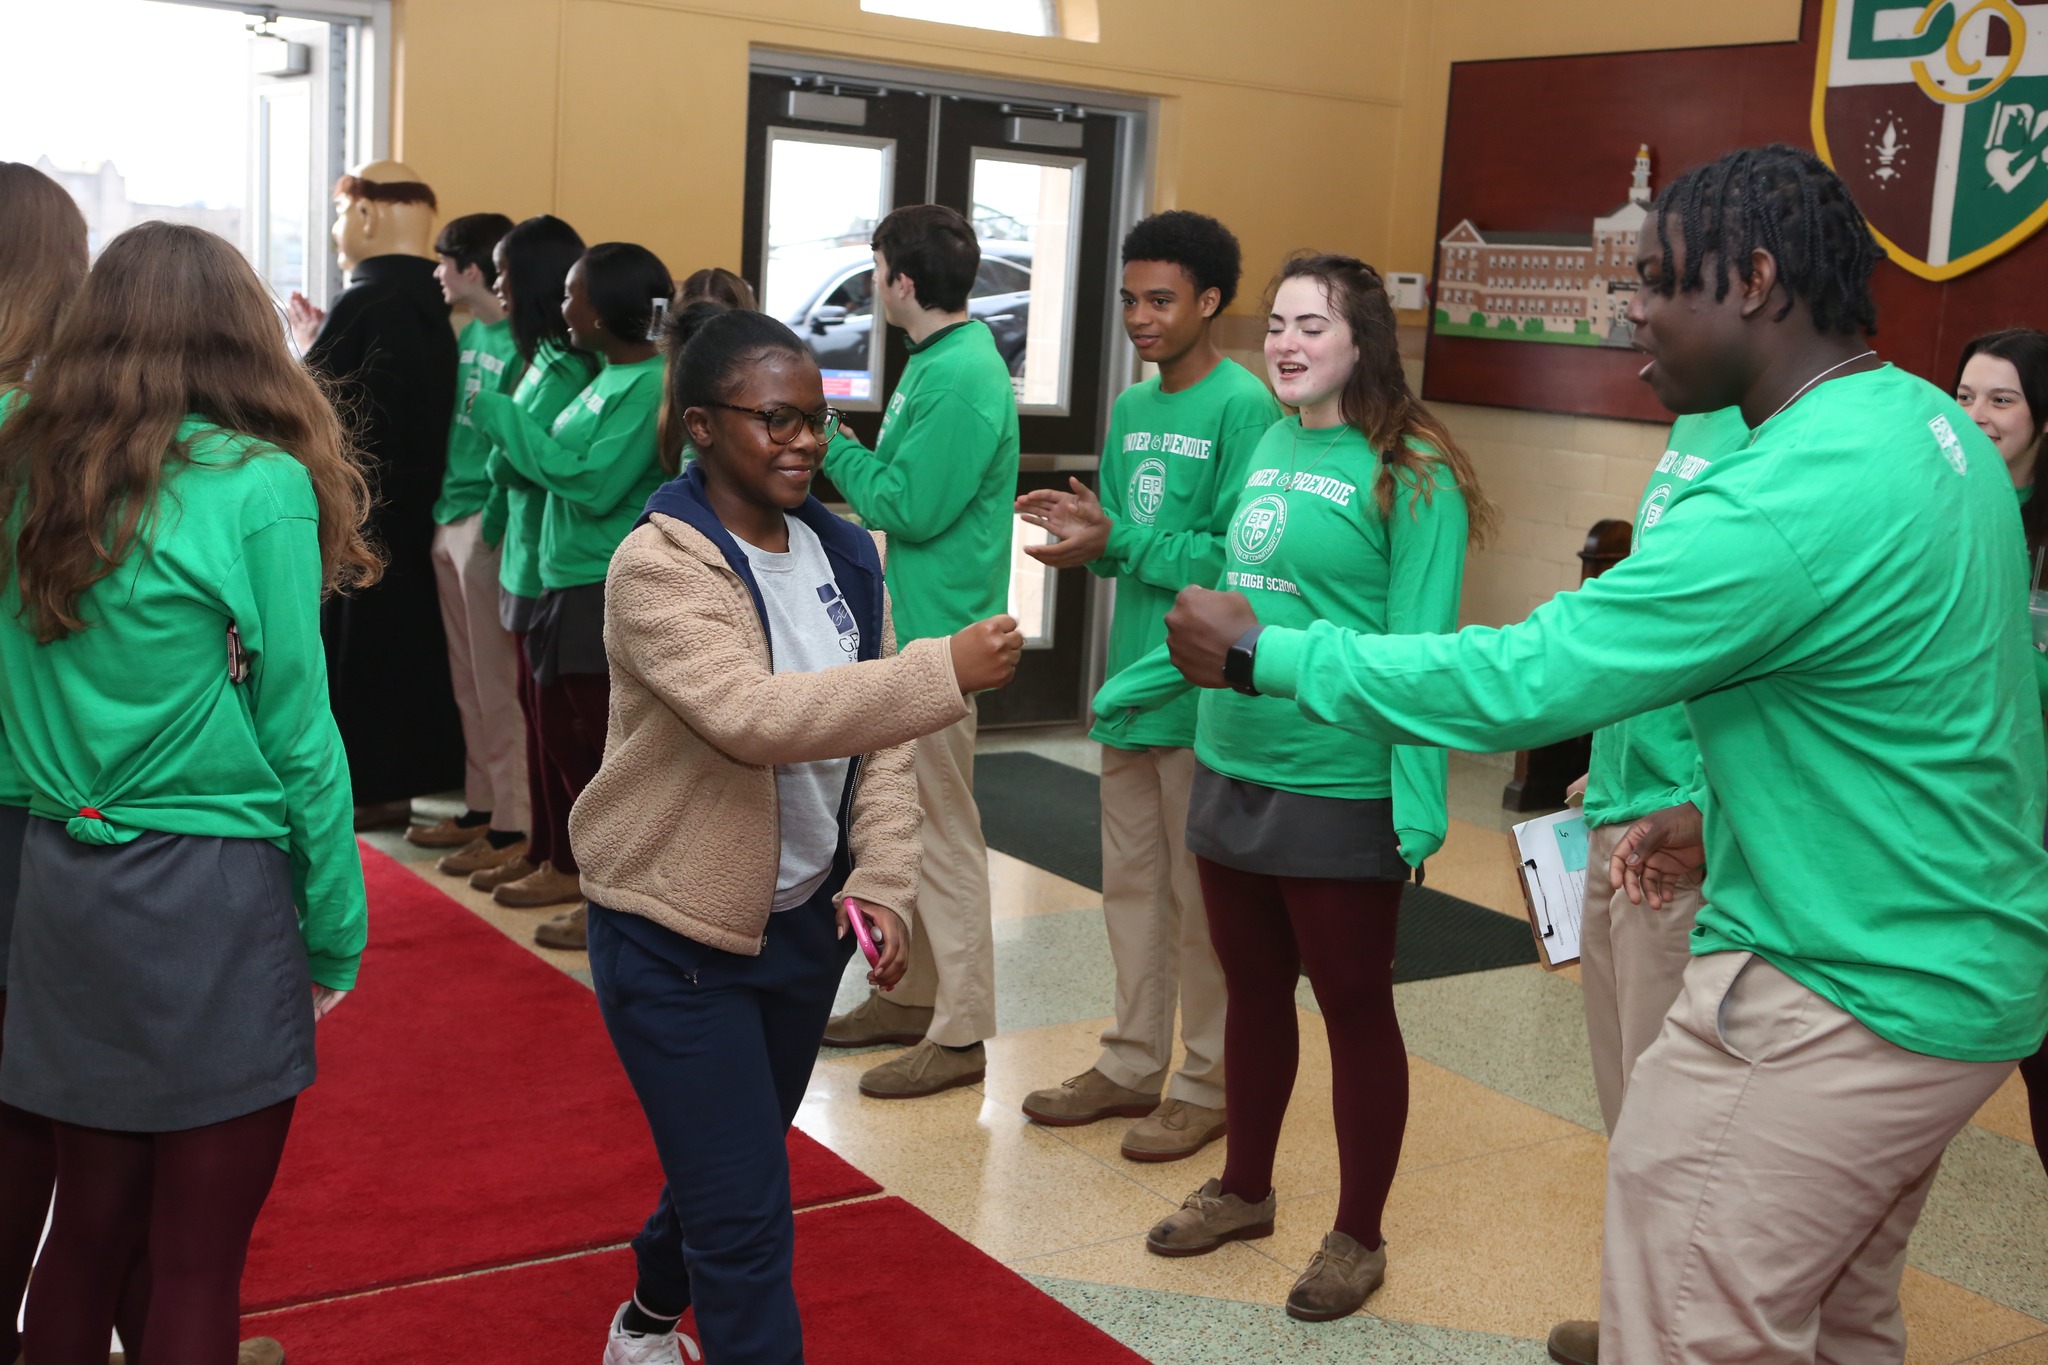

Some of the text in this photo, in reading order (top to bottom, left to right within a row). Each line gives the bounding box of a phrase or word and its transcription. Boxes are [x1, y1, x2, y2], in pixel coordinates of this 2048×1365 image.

[1150, 434, 1162, 451] &
[1276, 472, 1291, 487] &
[1291, 471, 1357, 507] PRENDIE
[1239, 572, 1264, 590] HIGH
[1266, 577, 1301, 596] SCHOOL
